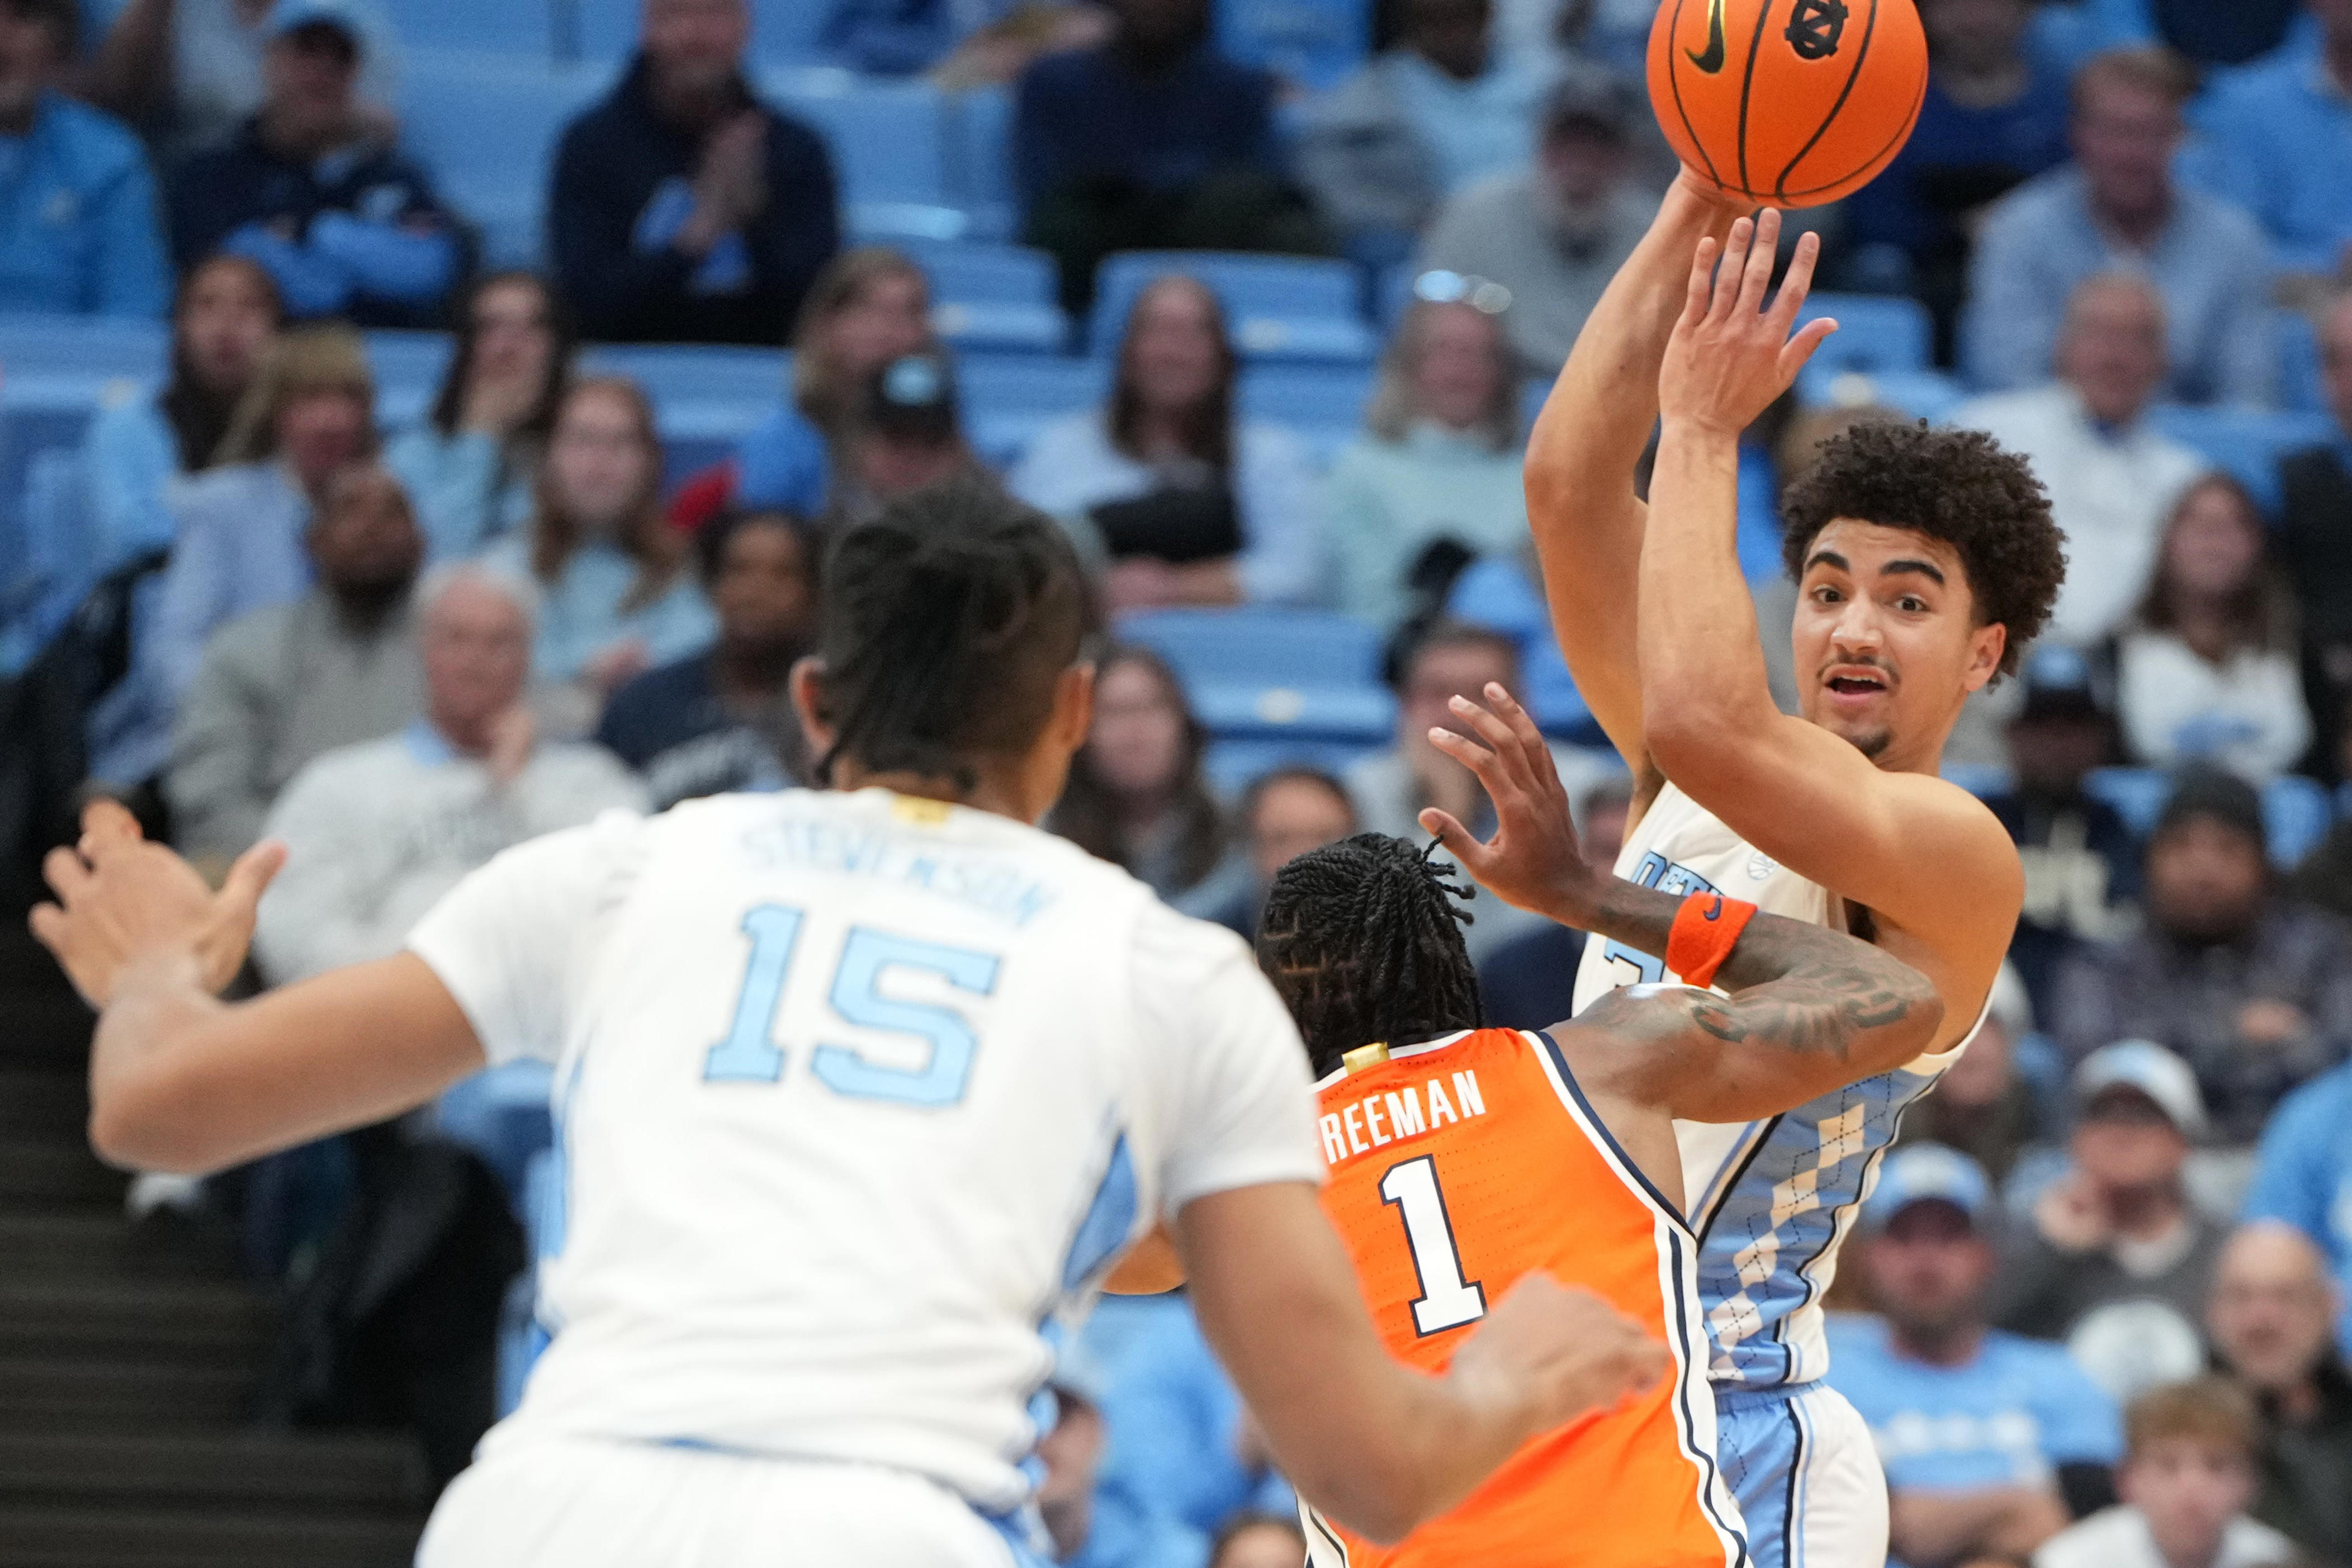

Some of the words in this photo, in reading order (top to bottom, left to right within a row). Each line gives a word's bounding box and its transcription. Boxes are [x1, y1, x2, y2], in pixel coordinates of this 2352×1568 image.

[702, 902, 1001, 1108] 15
[1318, 1069, 1487, 1164] REEMAN
[1378, 1153, 1489, 1339] 1
